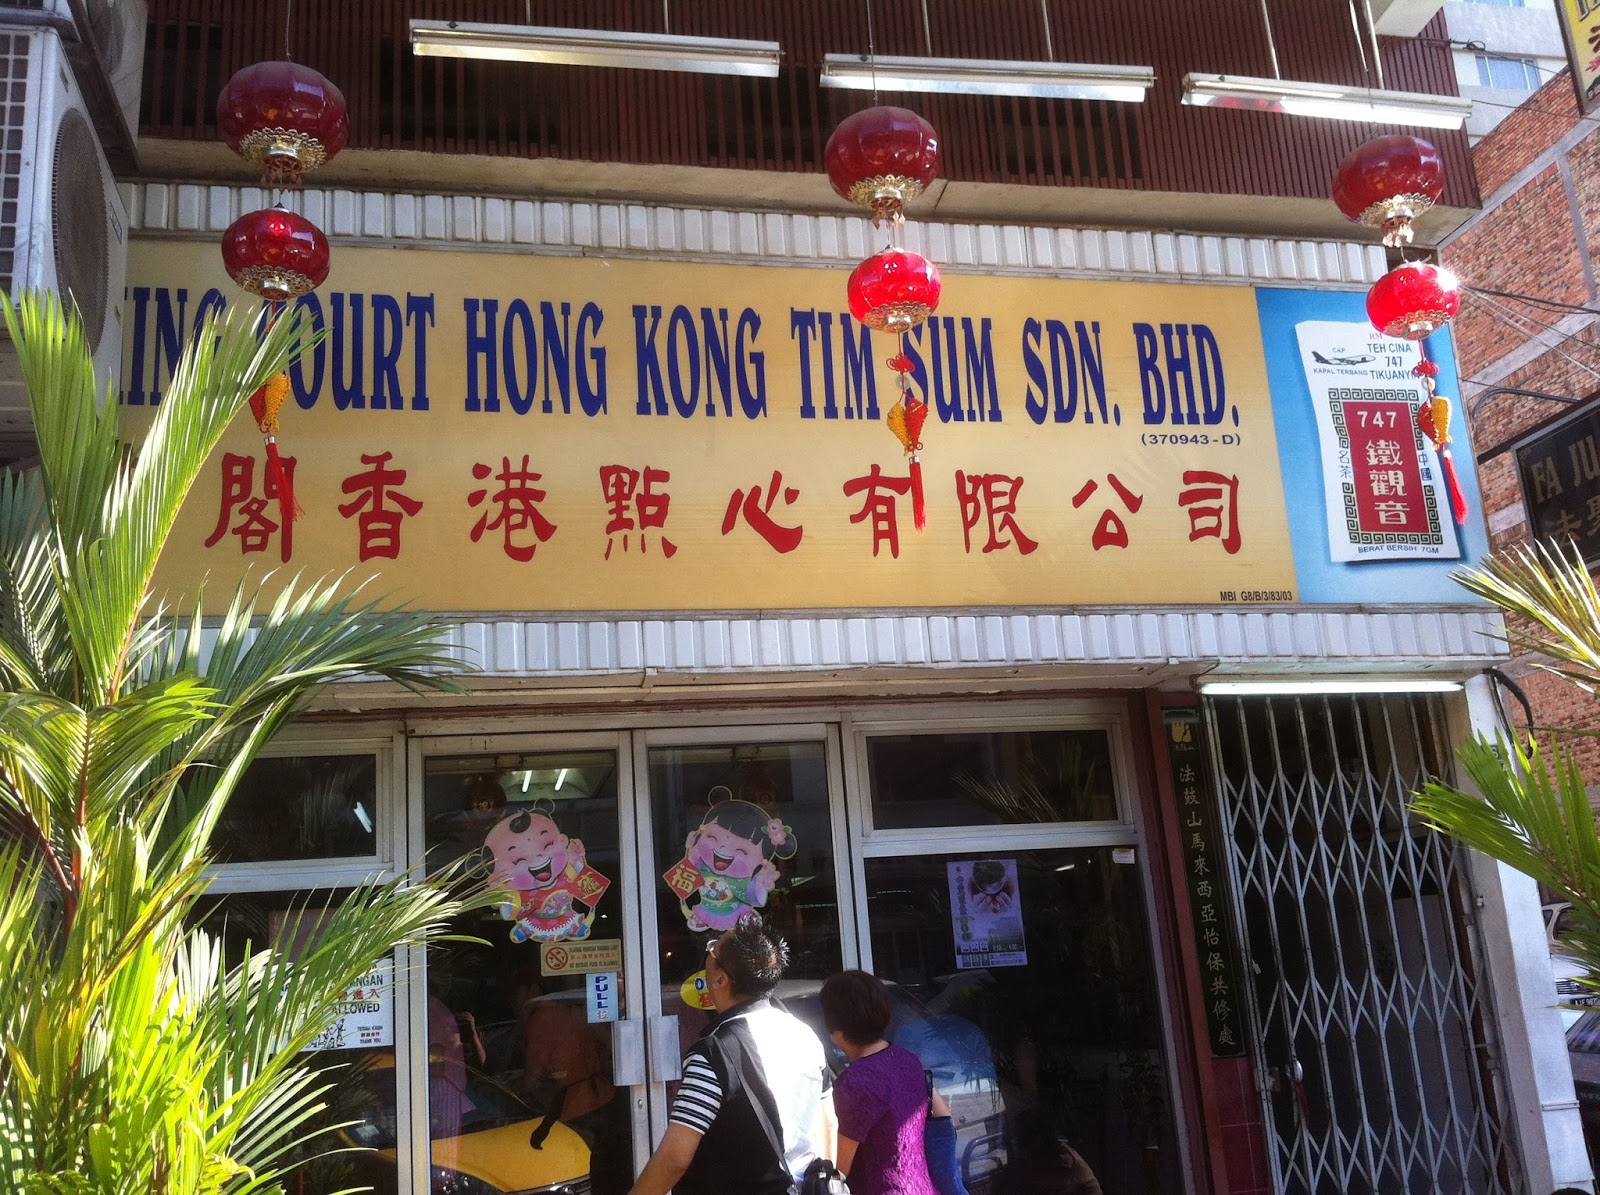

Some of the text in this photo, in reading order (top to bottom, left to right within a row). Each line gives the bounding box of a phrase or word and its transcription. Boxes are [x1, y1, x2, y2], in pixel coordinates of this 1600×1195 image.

[120, 286, 1240, 428] ING OURT HONG KONG TIM SUM SDN. BHD.
[1367, 342, 1412, 353] TEH CINA
[1384, 356, 1402, 367] 747
[1313, 367, 1368, 376] KAPAL TERBANG
[1356, 410, 1397, 428] 747
[1338, 450, 1352, 479] 名茶
[1365, 439, 1410, 525] 鐵觀音
[1530, 456, 1564, 504] FA
[120, 447, 1242, 563] 閣香港點心有限公司
[1358, 545, 1384, 553] BERAT
[1220, 590, 1293, 601] MBI G8/B/3/83/03
[671, 863, 699, 894] 福
[595, 975, 609, 1009] PULL
